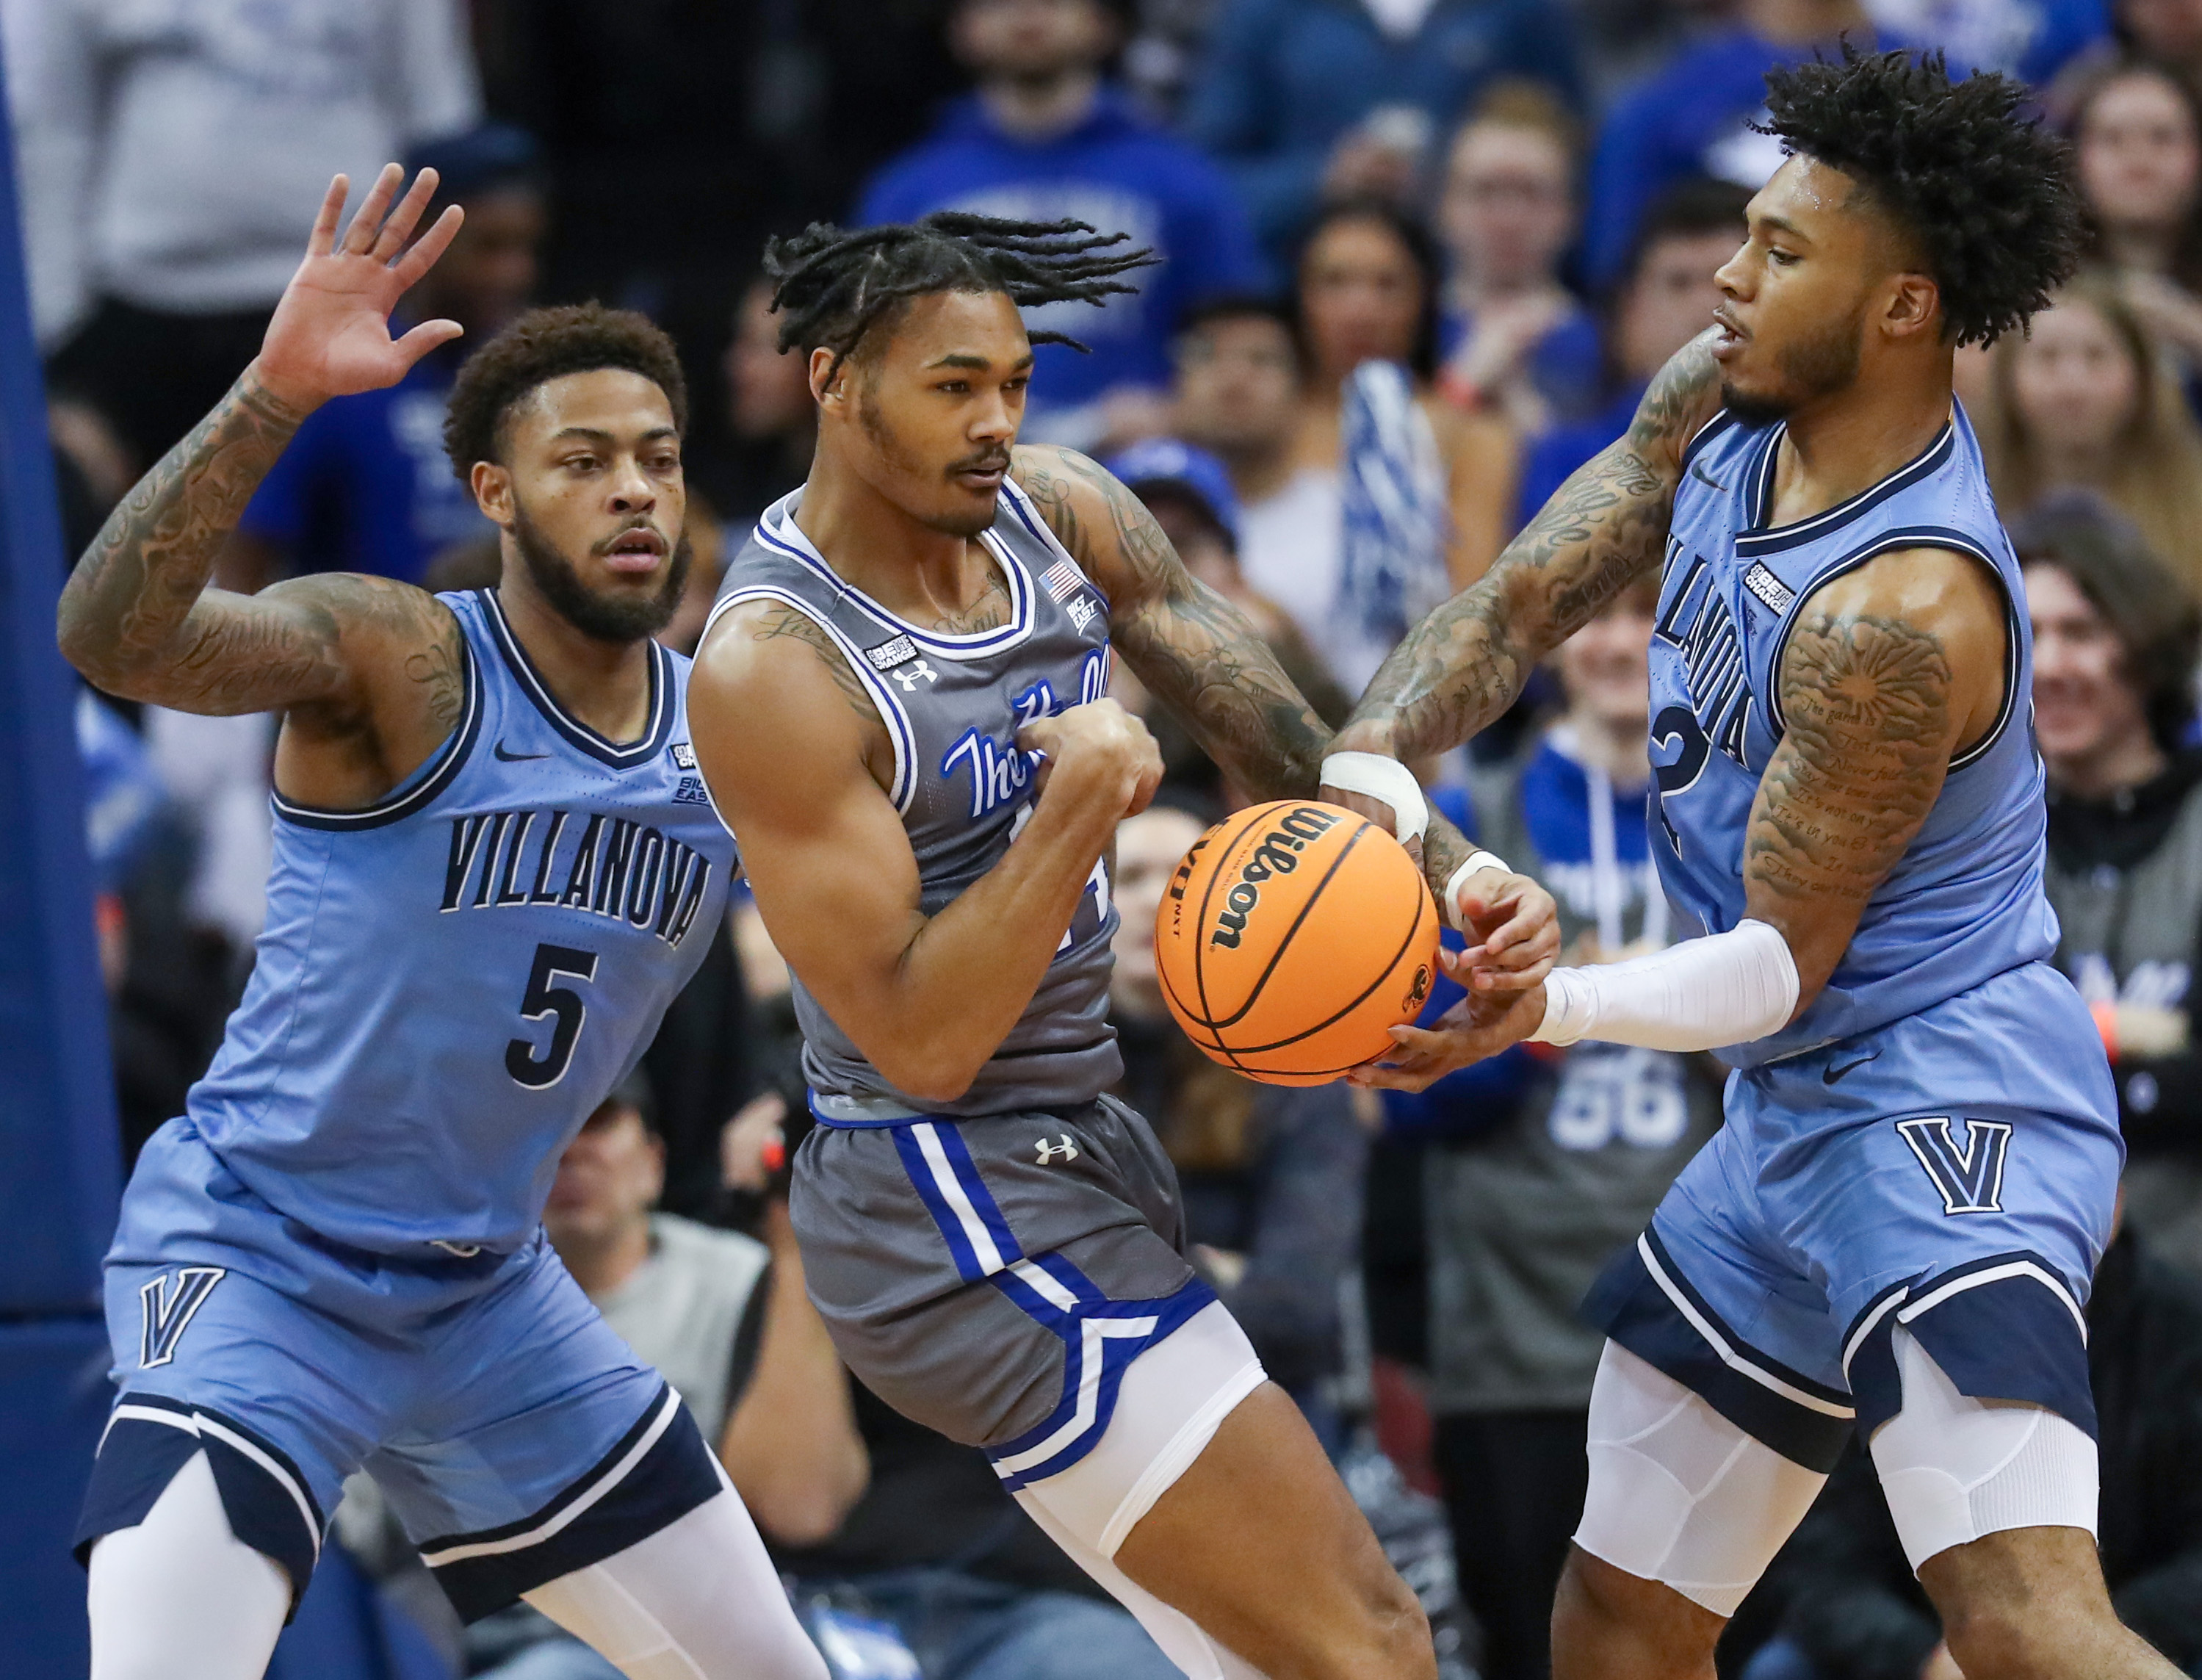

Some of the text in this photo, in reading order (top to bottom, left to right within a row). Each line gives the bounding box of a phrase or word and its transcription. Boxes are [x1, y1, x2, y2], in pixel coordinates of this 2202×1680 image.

[1066, 594, 1085, 619] BIG
[1072, 599, 1097, 630] EAST
[1745, 574, 1787, 616] CHANGE
[874, 646, 917, 670] CHANGE
[943, 730, 1028, 818] The
[439, 810, 712, 951] VILLANOVA
[1173, 903, 1183, 940] NXT
[1211, 807, 1344, 949] Wilson
[505, 943, 599, 1090] 5
[1895, 1116, 2013, 1216] V
[138, 1267, 226, 1369] V
